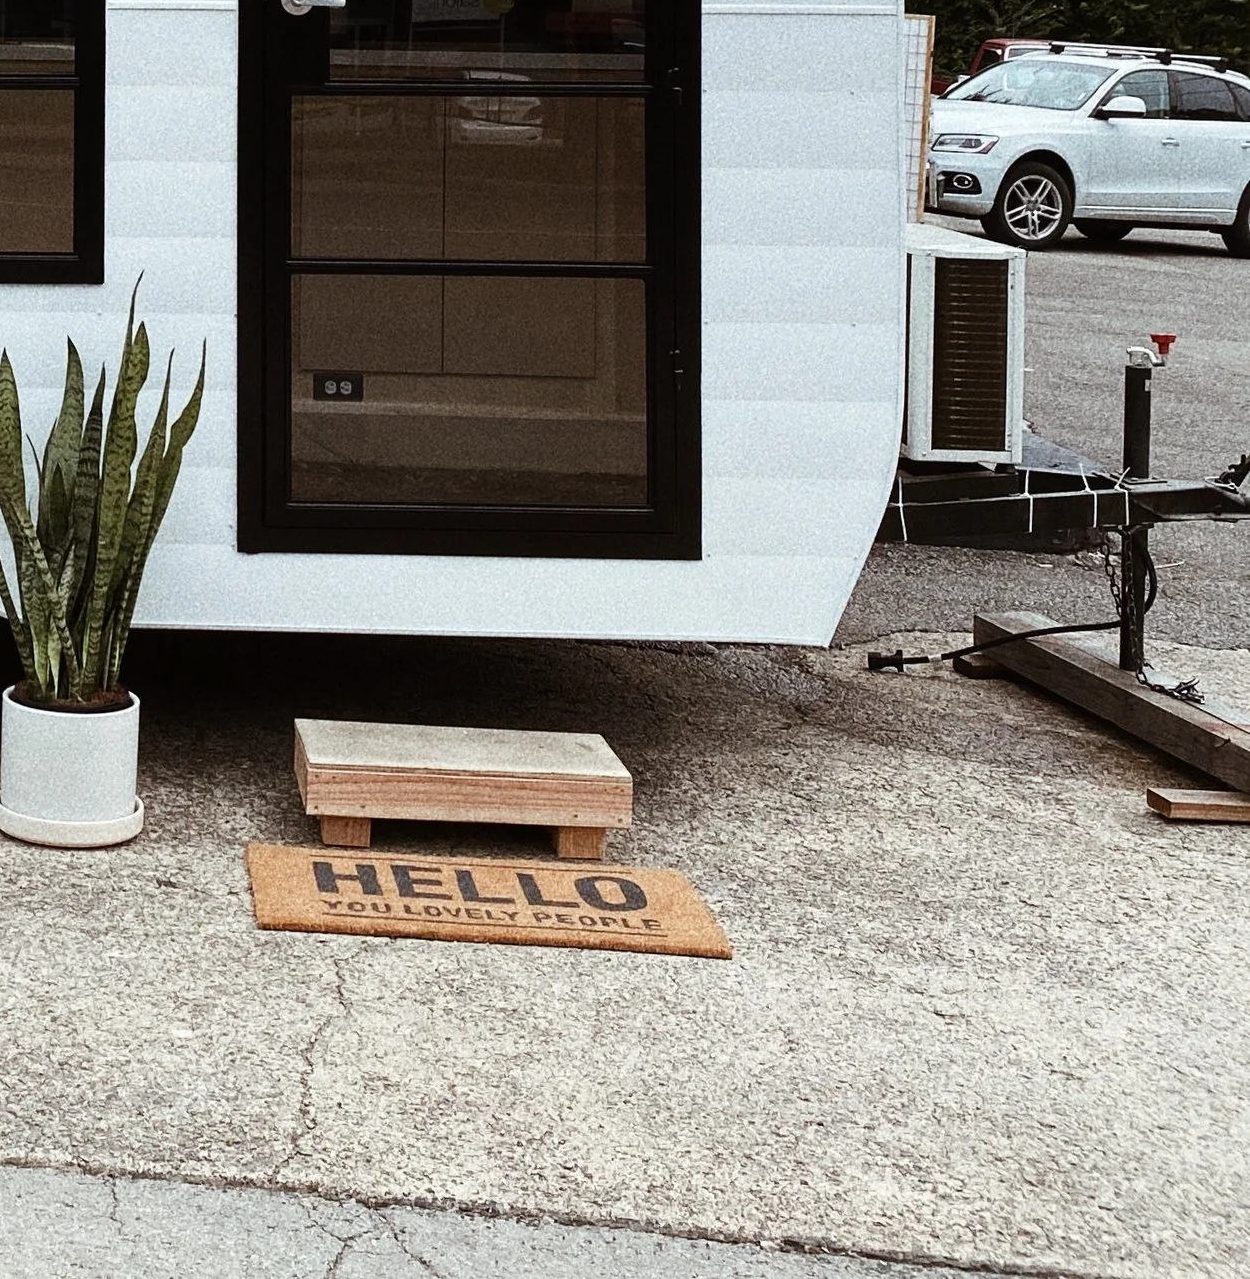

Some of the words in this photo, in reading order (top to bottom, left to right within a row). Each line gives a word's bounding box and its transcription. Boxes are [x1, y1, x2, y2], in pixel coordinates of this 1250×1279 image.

[312, 861, 648, 912] HELLO
[322, 900, 392, 915] YOU
[404, 904, 521, 923] LOVELY
[533, 912, 662, 931] PEOPLE
